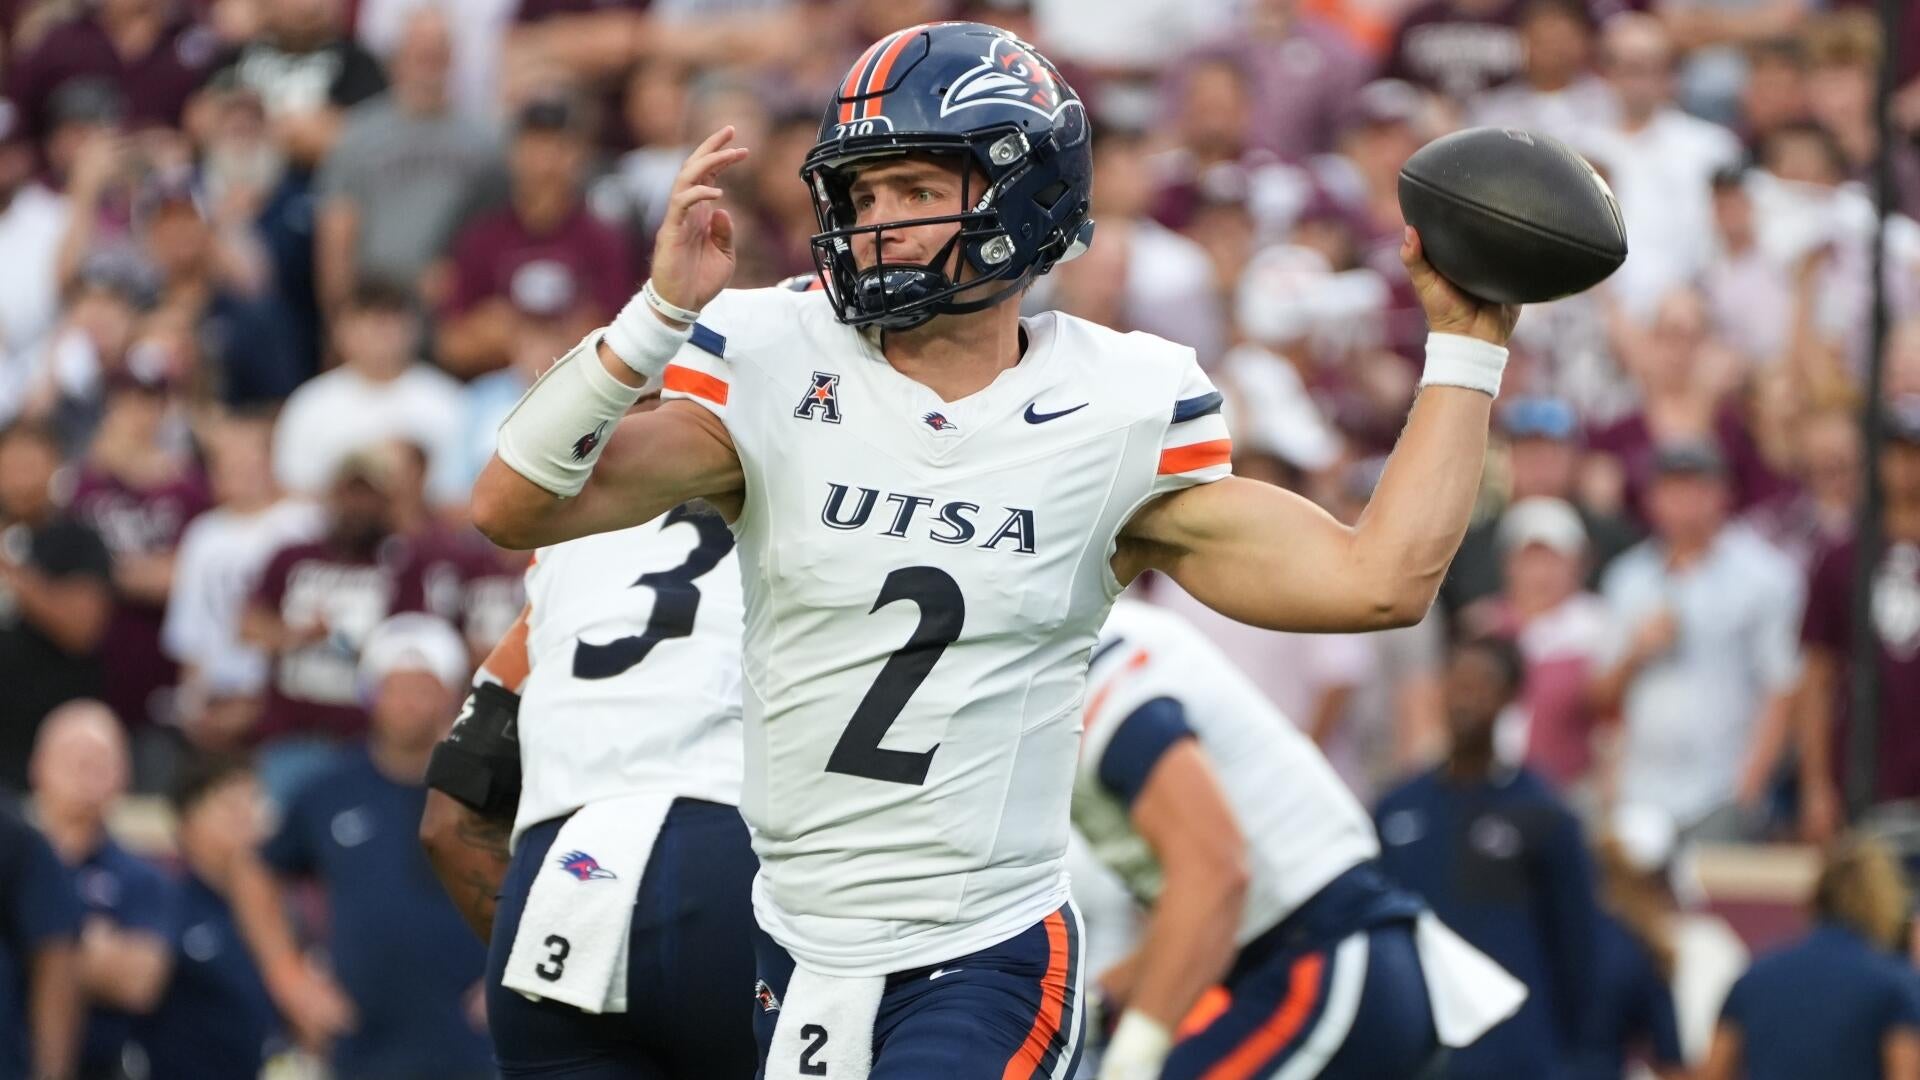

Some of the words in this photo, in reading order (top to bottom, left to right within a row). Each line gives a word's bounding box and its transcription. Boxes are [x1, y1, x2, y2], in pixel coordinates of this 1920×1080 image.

[821, 482, 1037, 554] UTSA
[573, 498, 735, 680] 3
[825, 565, 966, 786] 2
[535, 934, 570, 982] 3
[799, 1023, 828, 1076] 2
